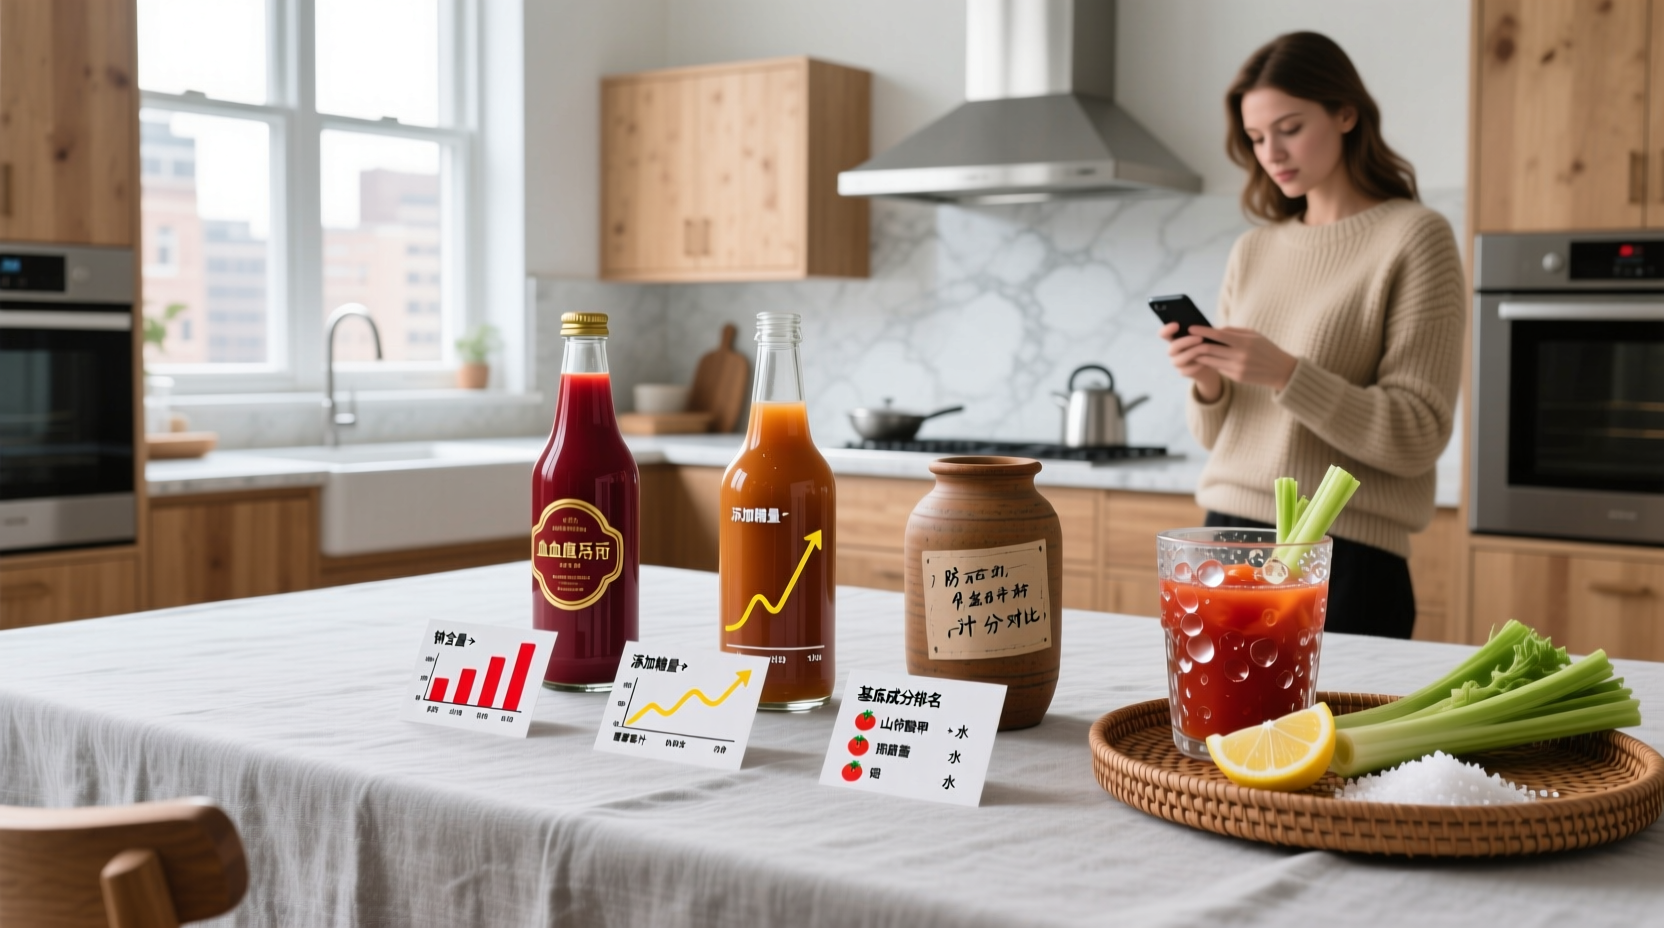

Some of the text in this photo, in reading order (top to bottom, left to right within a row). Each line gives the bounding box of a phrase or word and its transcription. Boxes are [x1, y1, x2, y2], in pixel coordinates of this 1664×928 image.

[955, 725, 969, 740] 水
[948, 750, 962, 765] 水
[942, 775, 956, 790] 水
